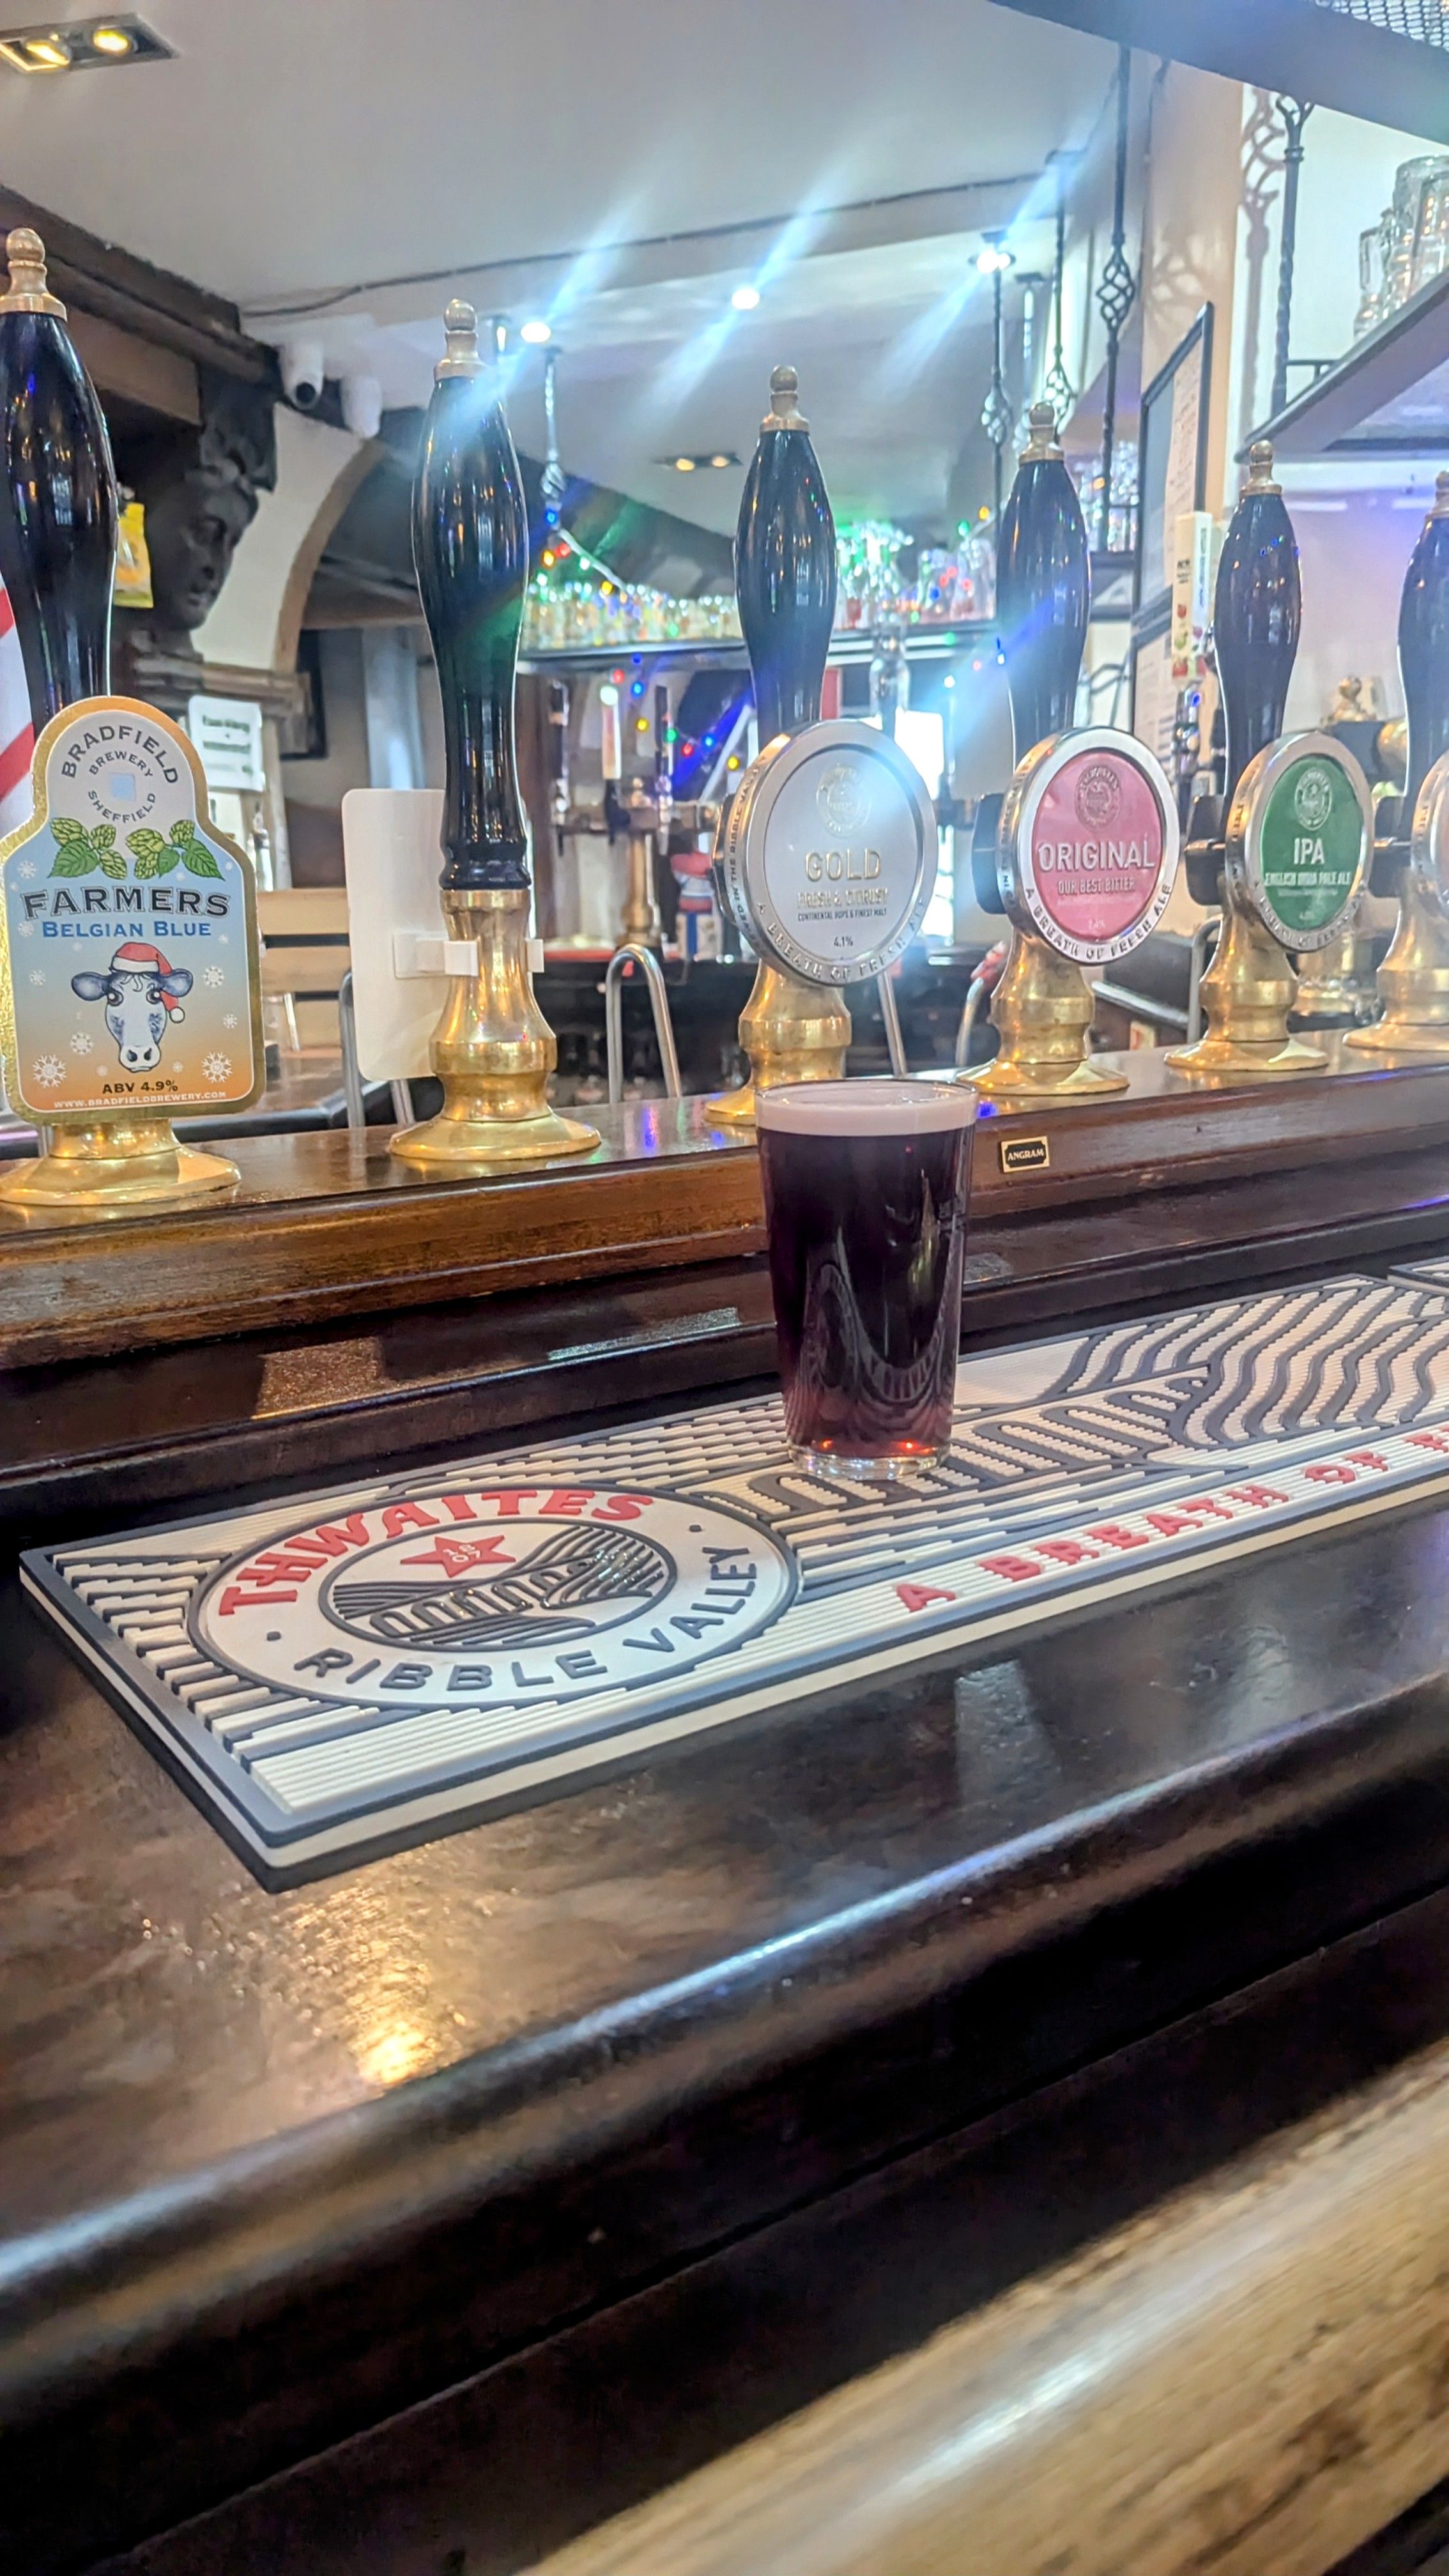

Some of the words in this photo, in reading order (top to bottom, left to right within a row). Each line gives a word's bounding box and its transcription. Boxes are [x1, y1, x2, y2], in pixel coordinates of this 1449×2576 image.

[62, 725, 178, 783] BRADFIELD
[89, 751, 153, 777] BREWERY
[88, 790, 156, 824] SHEFFIELD
[1038, 840, 1156, 873] ORIGINAL
[1294, 838, 1325, 865] IPA
[806, 848, 880, 882] GOLD
[834, 889, 842, 907] &
[1058, 879, 1077, 896] OUR
[1080, 878, 1101, 895] BEST
[21, 886, 231, 921] FARMERS
[798, 912, 832, 921] CONTINENTAL
[42, 921, 143, 938] BELGIAN
[154, 921, 211, 937] BLUE
[834, 936, 854, 947] 4.1%
[54, 1091, 226, 1108] WWW.BRADFIELDBREWERY.COM
[102, 1082, 135, 1094] ABV
[141, 1080, 178, 1092] 4.9%
[1008, 1148, 1045, 1161] ANGRAM
[894, 1583, 956, 1612] A
[978, 1485, 1289, 1581] BREATH
[1305, 1452, 1389, 1484] OF
[218, 1489, 654, 1616] THWAITES
[295, 1649, 608, 1691] RIBBLE
[623, 1545, 757, 1653] VALLEY
